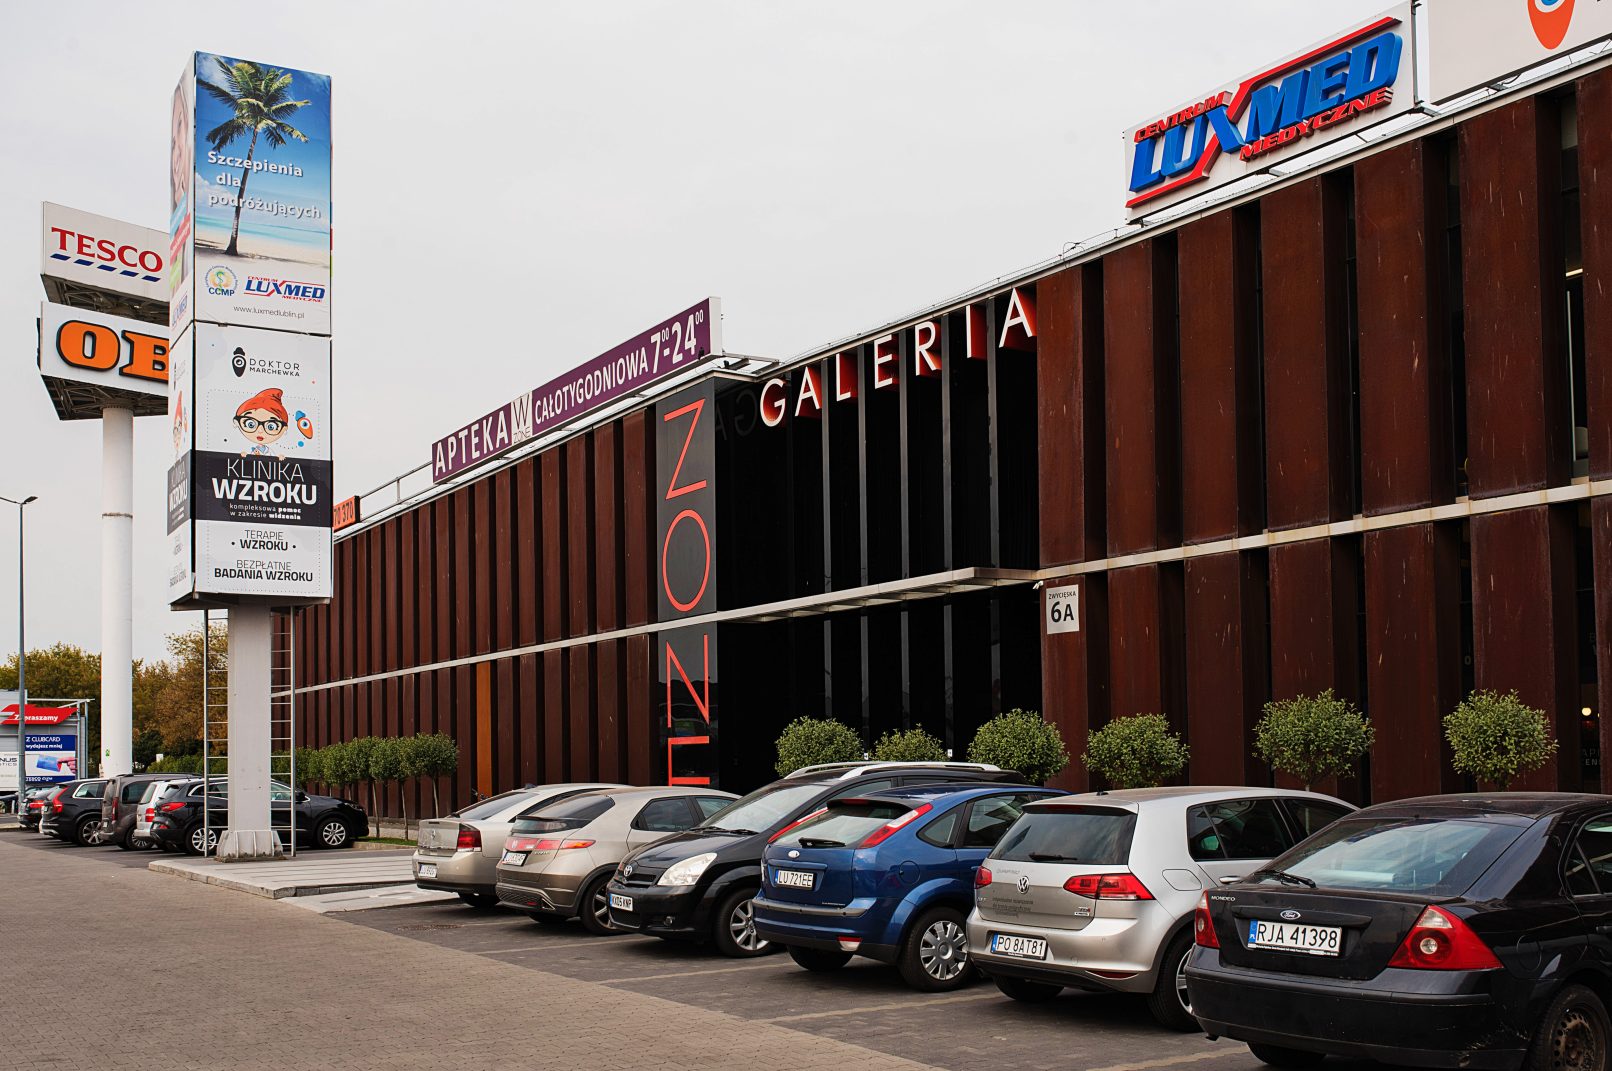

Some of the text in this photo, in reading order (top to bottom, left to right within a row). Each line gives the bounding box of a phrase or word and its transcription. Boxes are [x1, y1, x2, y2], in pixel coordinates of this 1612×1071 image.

[1129, 32, 1403, 192] LUXMED
[1133, 91, 1231, 143] CENTRUM
[1239, 86, 1393, 161] MEDYCZNE
[207, 150, 304, 178] Szczepienia
[216, 172, 242, 188] dla
[208, 194, 321, 219] podróżujących
[51, 226, 163, 273] TESCO
[208, 286, 235, 297] CCMP
[245, 279, 325, 299] LUXMED
[233, 305, 305, 319] www.luxmedlublin.pl
[249, 358, 300, 371] DOKTOR
[760, 287, 1035, 427] GALERIA
[249, 367, 301, 377] MARCHEWKA
[434, 410, 509, 477] APTEKA
[534, 346, 649, 425] CAŁOTYGODNIOWA
[227, 458, 305, 482] KLINIKA
[211, 477, 317, 505] WZROKU
[229, 503, 276, 512] kompleksowa
[268, 512, 301, 520] widzenia
[244, 529, 284, 541] TERAPIE
[240, 538, 289, 551] WZROKU
[236, 559, 292, 571] BEZPŁATNE
[214, 567, 313, 582] BADANIA WZROKU
[1048, 591, 1077, 600] ZWYCIĘSKA
[1050, 600, 1075, 623] 6A
[14, 713, 59, 723] Zpraszamy
[779, 871, 813, 887] LU 721EE
[1257, 923, 1338, 949] RJA 41398
[997, 936, 1044, 956] PO 8AT81
